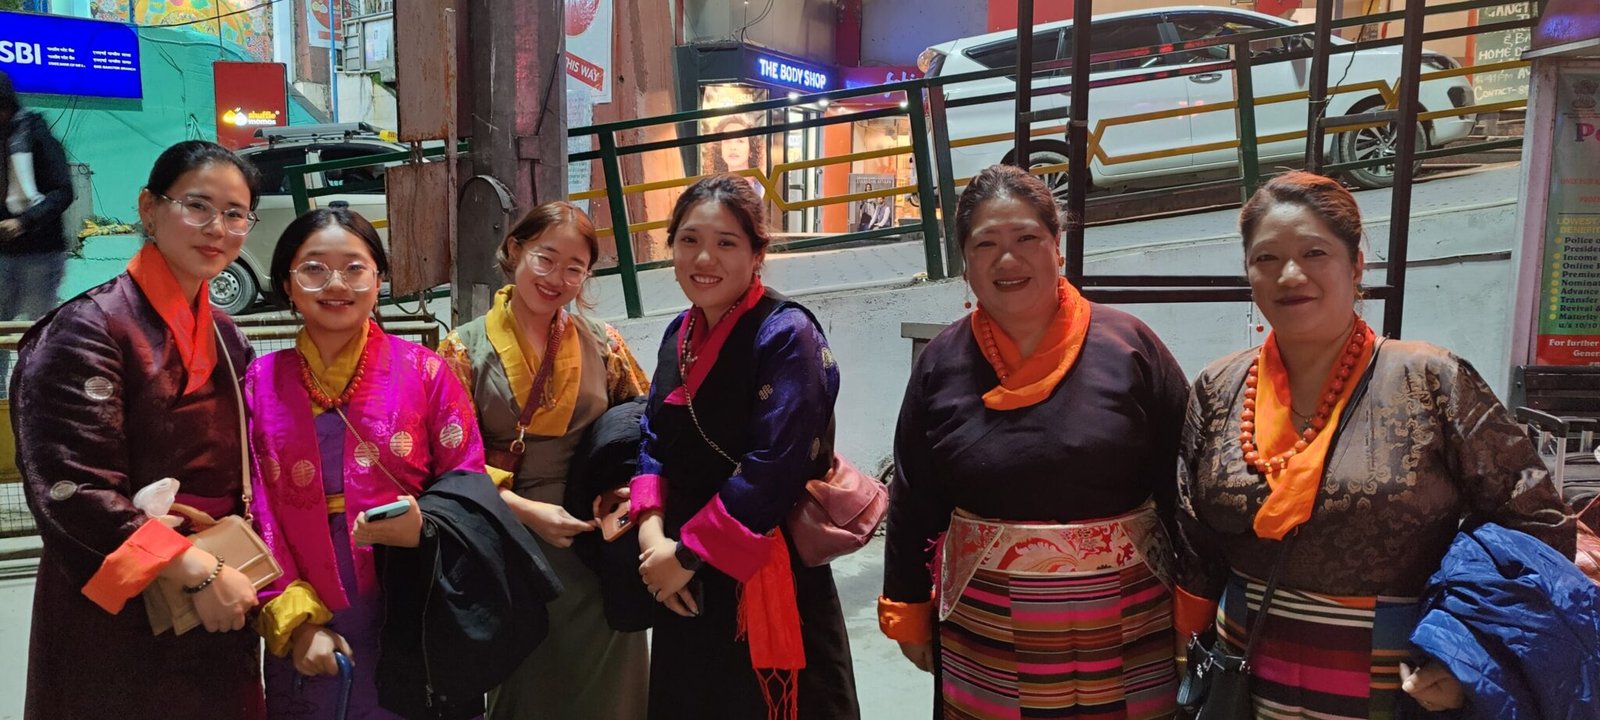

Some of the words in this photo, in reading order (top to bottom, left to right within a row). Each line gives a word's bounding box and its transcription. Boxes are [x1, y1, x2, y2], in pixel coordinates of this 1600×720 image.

[0, 40, 42, 65] SBI
[1478, 47, 1511, 60] HOME
[581, 64, 600, 82] WAY
[759, 58, 779, 79] THE
[780, 64, 804, 85] BODY
[804, 70, 827, 89] SHOP
[248, 110, 277, 119] shuffle
[1564, 236, 1593, 244] Police
[1560, 296, 1598, 304] Transfer
[1558, 313, 1598, 322] Maturity
[1549, 338, 1566, 347] For
[1567, 339, 1599, 347] further
